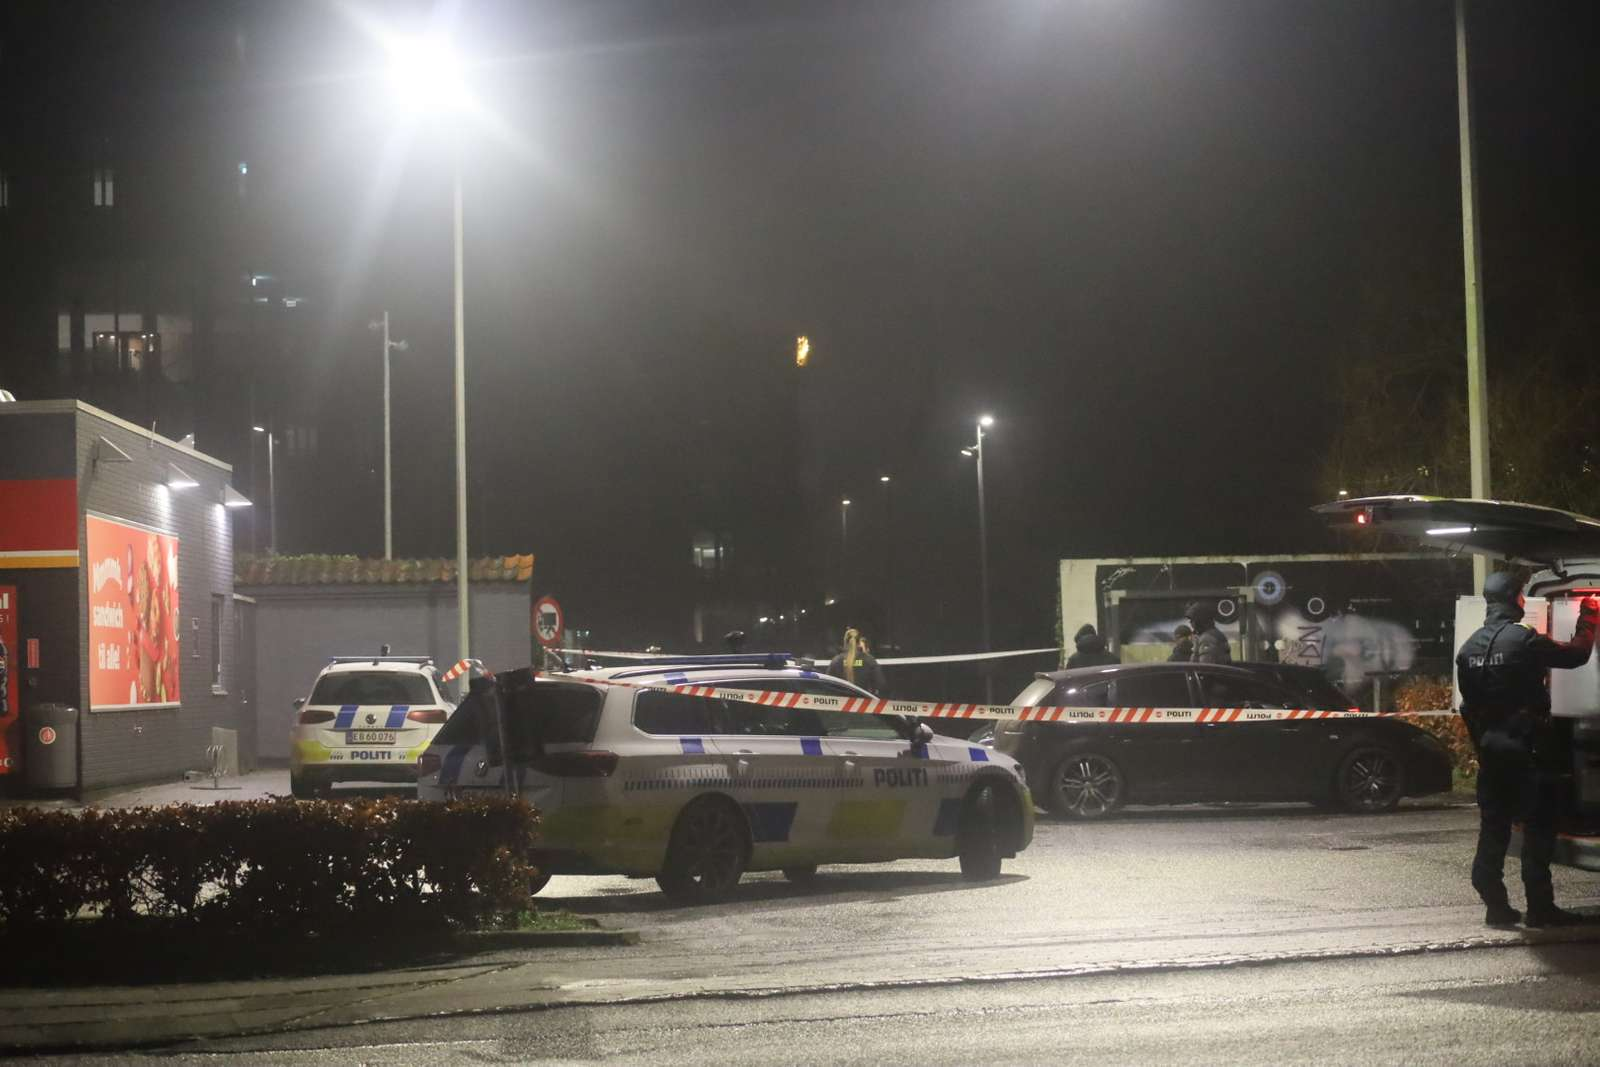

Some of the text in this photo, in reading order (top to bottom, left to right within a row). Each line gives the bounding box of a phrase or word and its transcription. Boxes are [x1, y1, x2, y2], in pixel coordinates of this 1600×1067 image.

[1468, 653, 1504, 668] POITI
[813, 697, 839, 705] POLITI
[989, 707, 1015, 715] POLITI
[366, 732, 377, 741] 60
[350, 750, 392, 760] POLITI
[873, 767, 929, 788] POLITI
